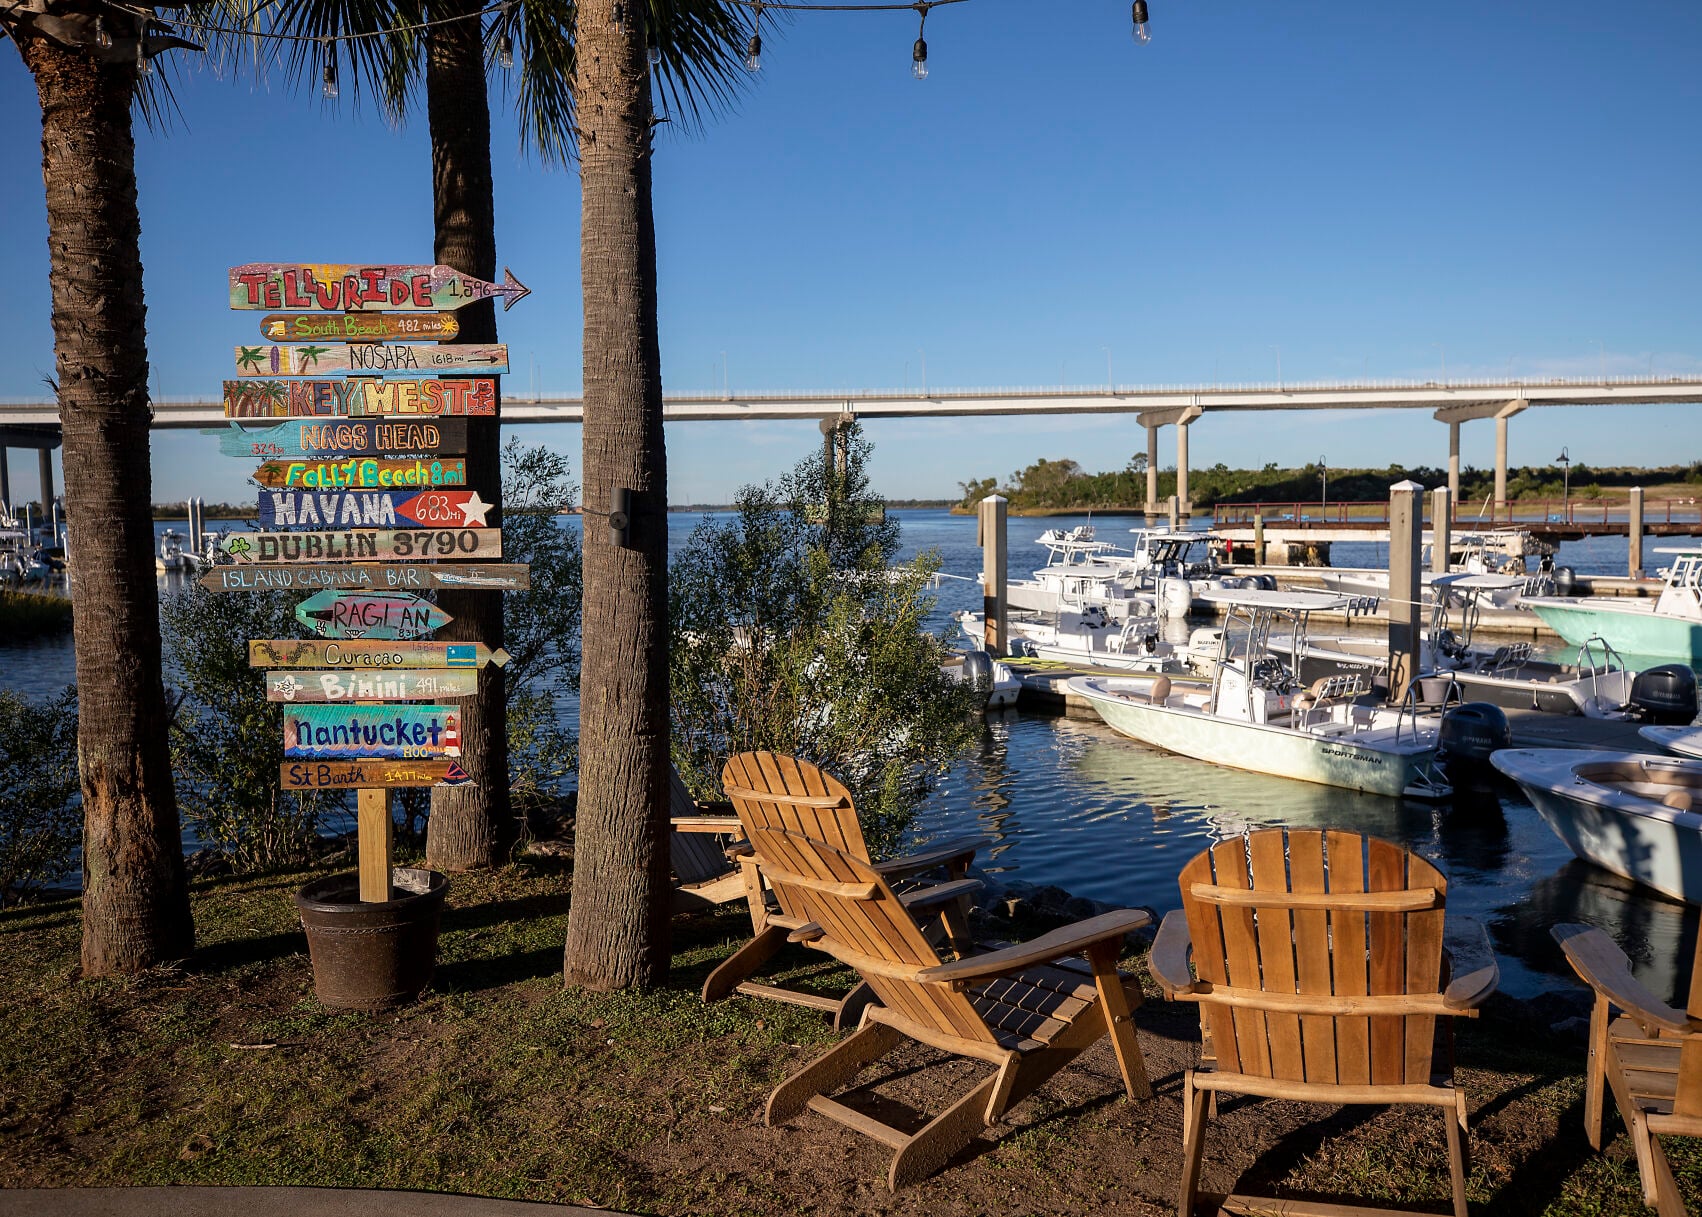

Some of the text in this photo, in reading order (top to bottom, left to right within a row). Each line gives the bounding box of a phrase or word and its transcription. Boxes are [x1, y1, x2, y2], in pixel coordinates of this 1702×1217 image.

[239, 268, 491, 310] TELLURIDE 1,596
[295, 316, 340, 337] South
[344, 316, 389, 337] Beach
[398, 320, 421, 332] 482
[350, 345, 419, 370] NOSARA
[290, 381, 471, 416] KEY WEST
[300, 424, 440, 451] NAGS HEAD
[359, 460, 429, 487] Beach
[272, 493, 396, 525] HAVANA
[415, 495, 450, 520] 683
[258, 530, 479, 560] DUBLIN 3790
[222, 568, 420, 588] ISLAND CABANA BAR
[325, 644, 403, 666] Curaçao
[416, 677, 437, 693] 491
[1321, 747, 1383, 765] SPORTSMAN
[289, 765, 312, 786] St
[317, 765, 367, 786] Barth
[385, 771, 416, 782] 1477
